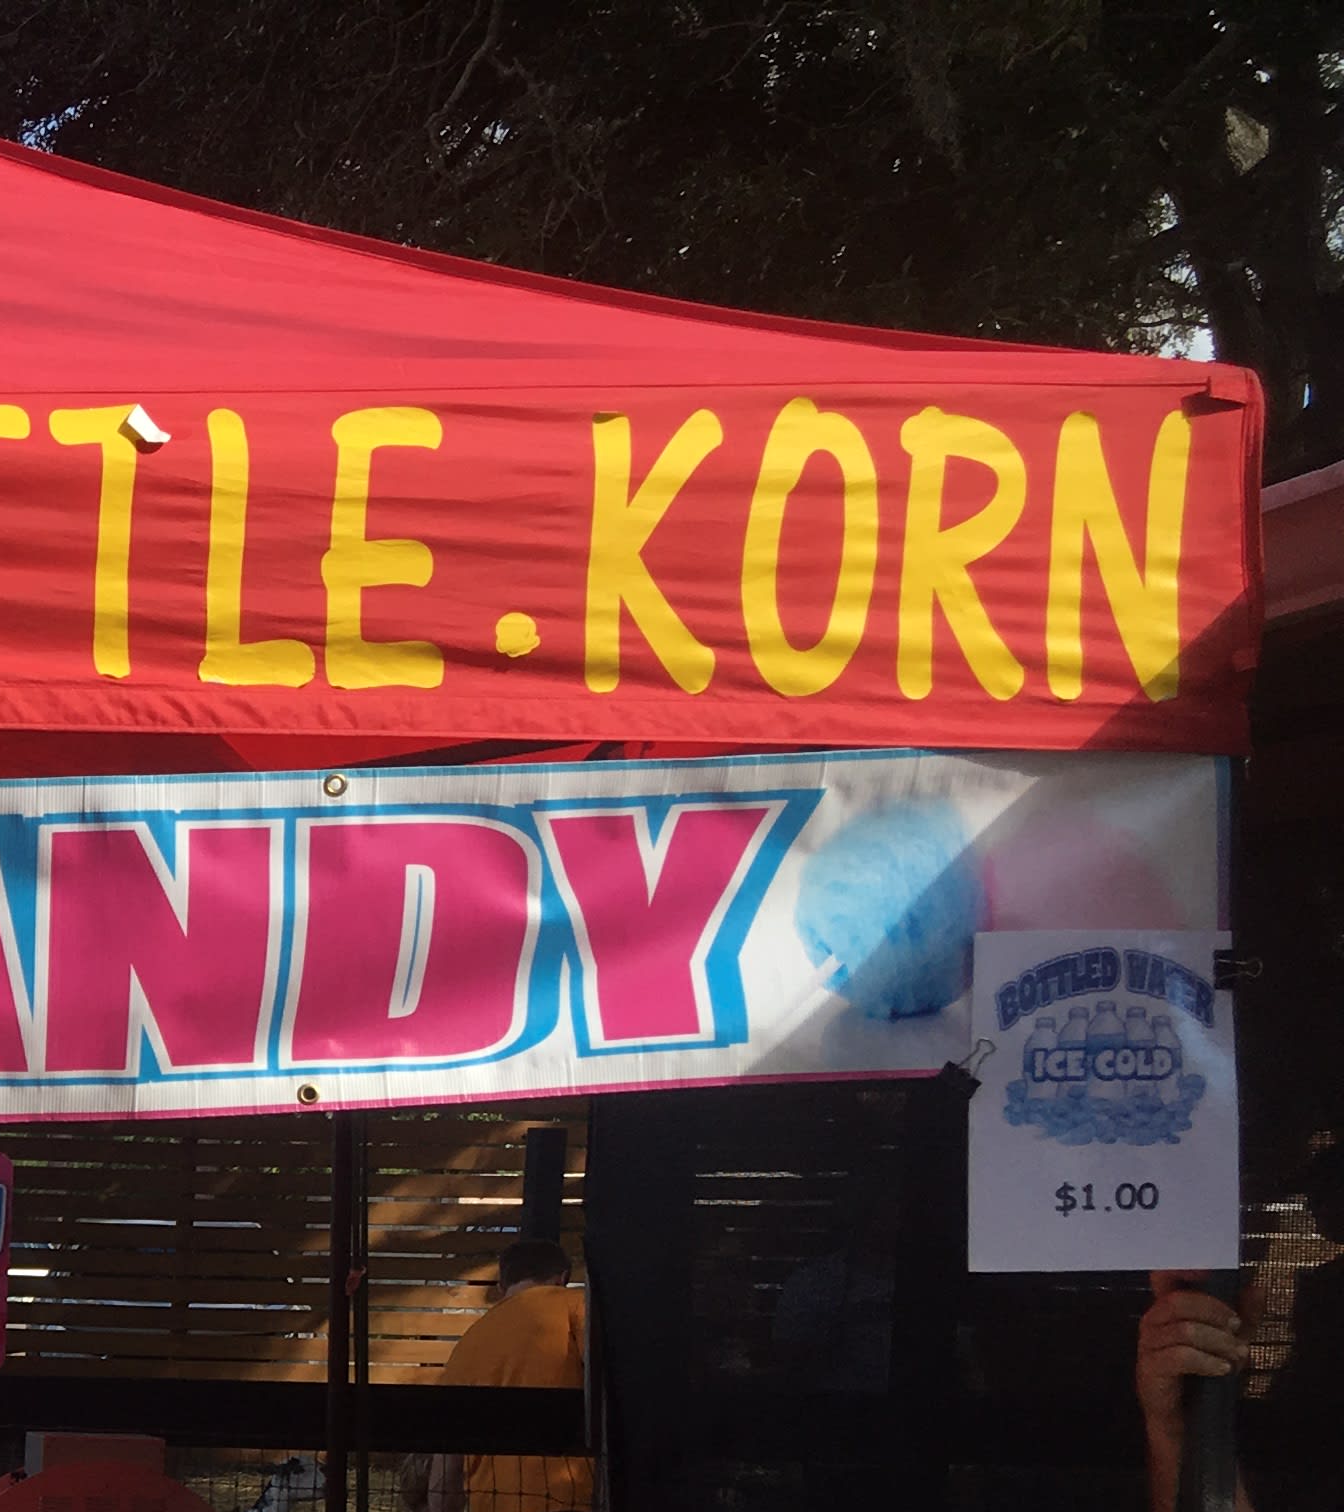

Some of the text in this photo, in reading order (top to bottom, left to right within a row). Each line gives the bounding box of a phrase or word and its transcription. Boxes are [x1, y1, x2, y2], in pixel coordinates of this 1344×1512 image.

[584, 398, 1192, 703] KORN
[995, 946, 1216, 1031] BOTTLED WATER
[1032, 1046, 1176, 1082] ICE COLD
[1055, 1181, 1160, 1217] $1.00
